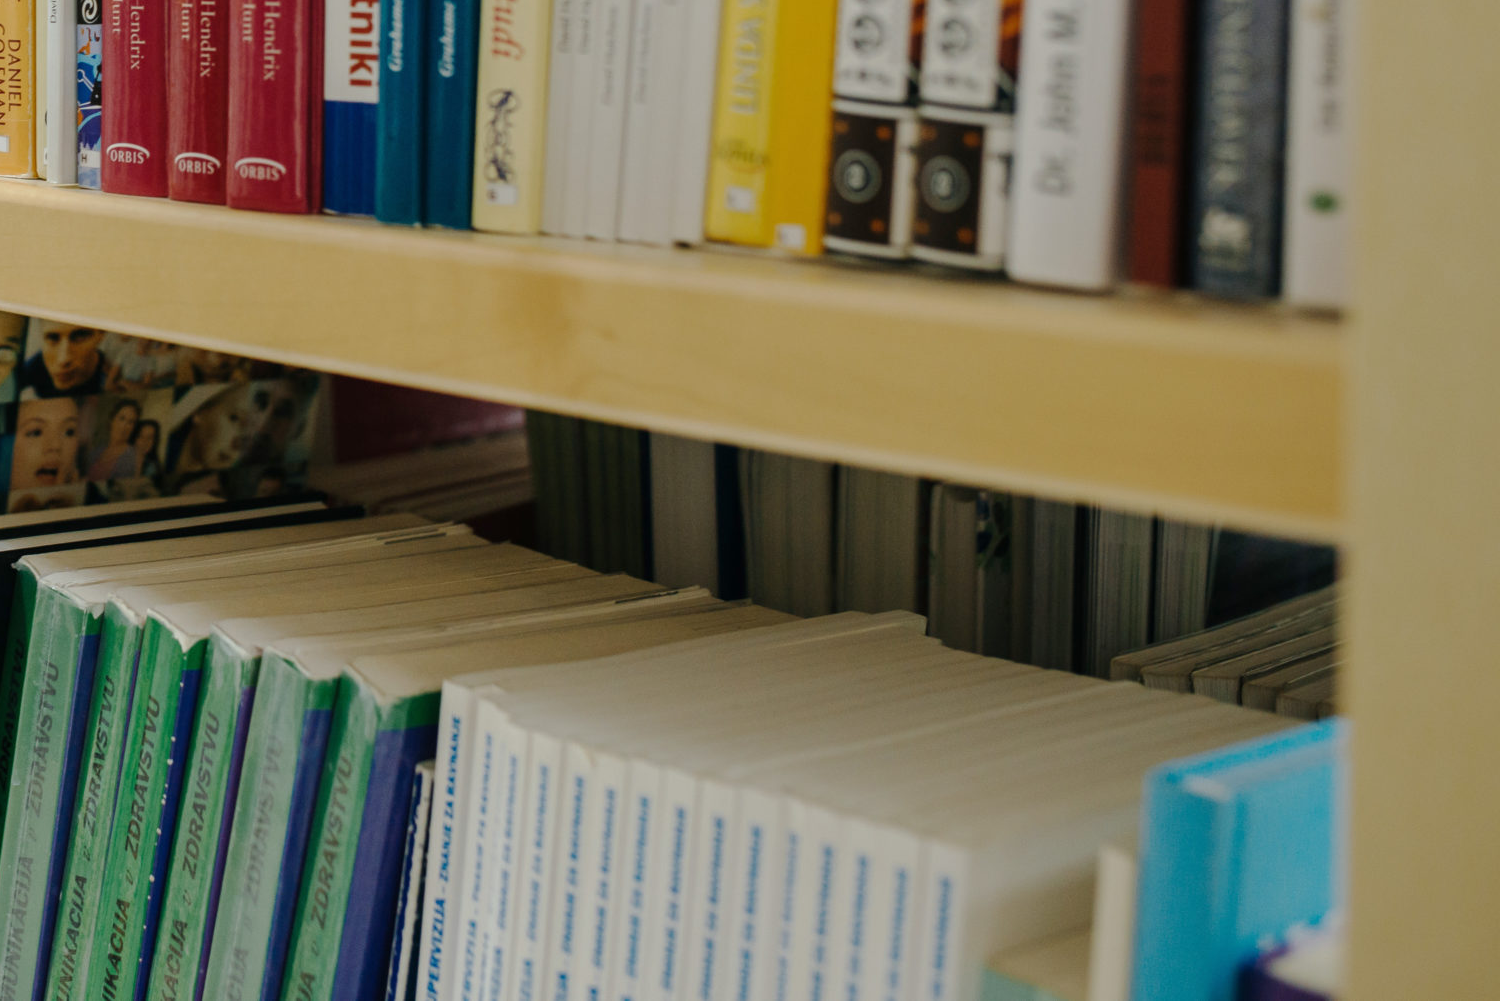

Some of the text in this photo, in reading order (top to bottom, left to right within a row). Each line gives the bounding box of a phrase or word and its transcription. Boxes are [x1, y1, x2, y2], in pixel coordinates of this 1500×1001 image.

[7, 38, 22, 112] DANIEL
[200, 0, 217, 77] Hendrix
[262, 0, 282, 81] Hendrix
[1039, 55, 1080, 135] John
[109, 148, 146, 165] ORBIS
[177, 159, 216, 176] ORBIS
[238, 164, 281, 182] ORBIS
[24, 661, 61, 819] ZDRAVSTVU
[83, 675, 116, 837] ZDRAVSTVU
[124, 695, 162, 860] ZDRAVSTVU
[182, 711, 221, 880] ZDRAVSTVU
[310, 755, 354, 930] ZDRAVSTVU
